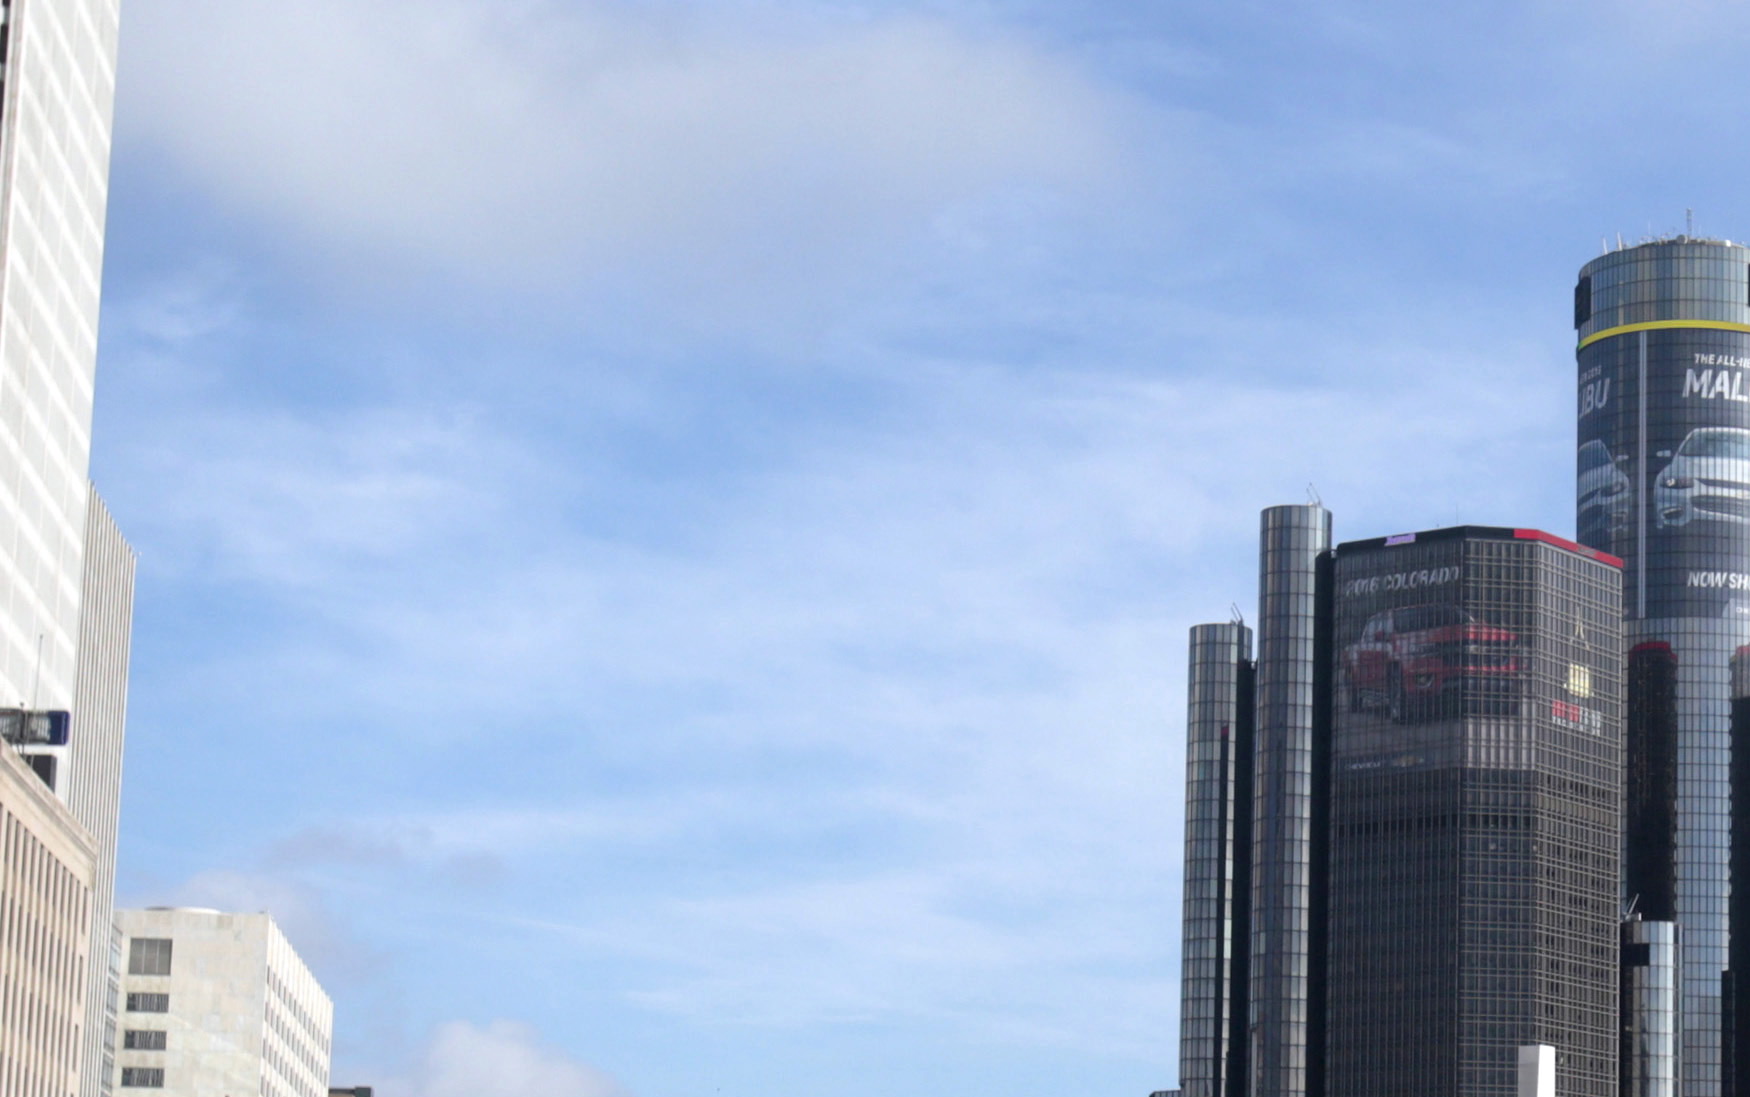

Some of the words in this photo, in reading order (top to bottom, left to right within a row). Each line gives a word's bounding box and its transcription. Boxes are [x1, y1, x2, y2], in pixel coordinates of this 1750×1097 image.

[1694, 353, 1715, 365] THE
[1385, 566, 1459, 591] COLORADO
[1687, 571, 1728, 588] NOW
